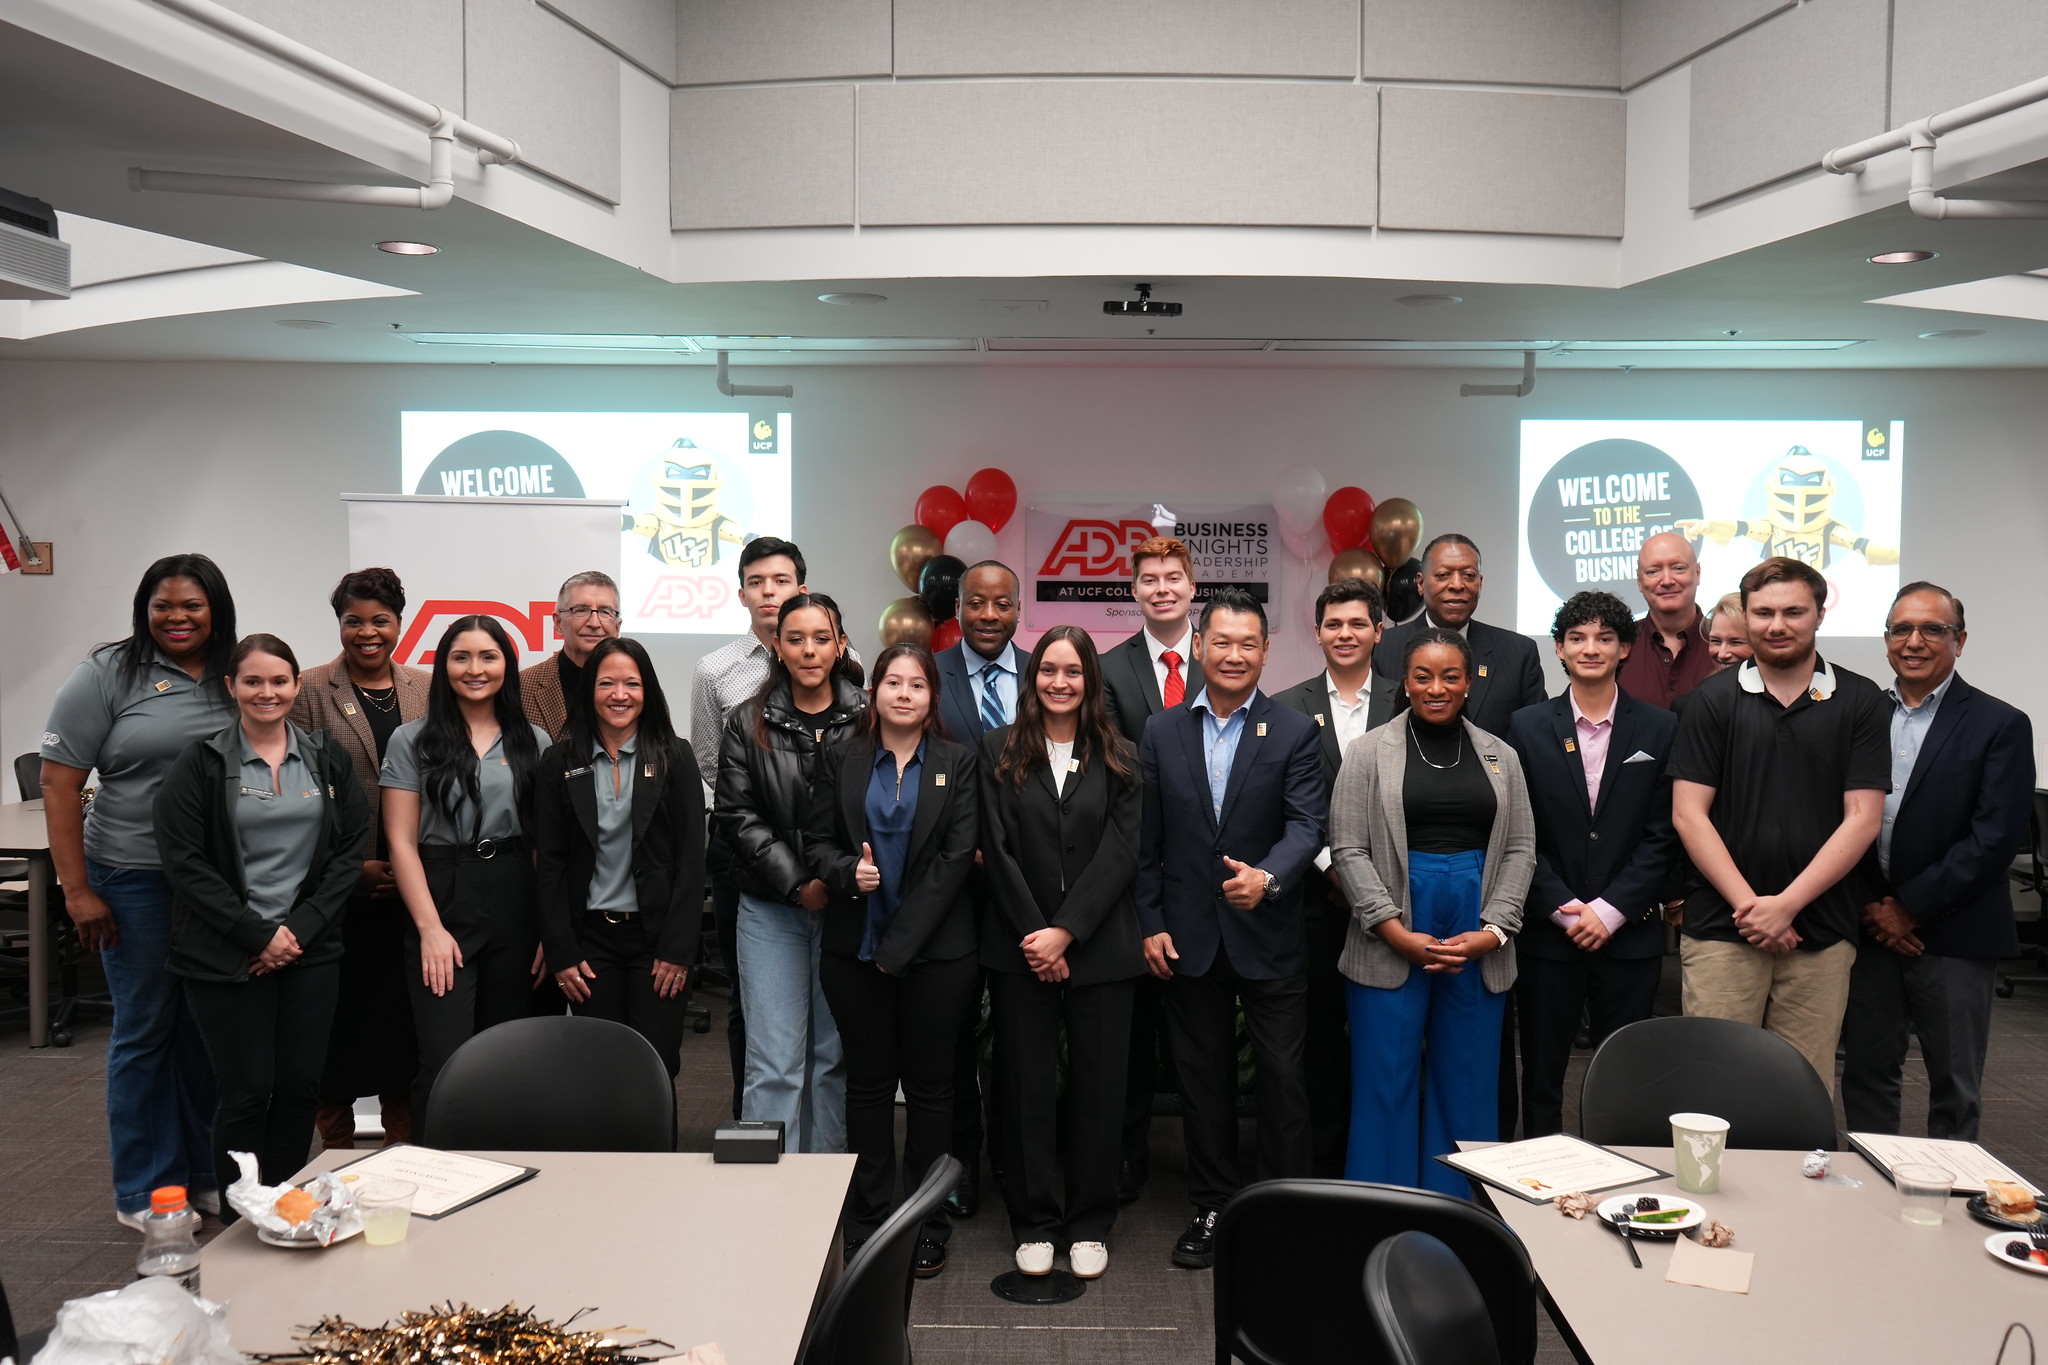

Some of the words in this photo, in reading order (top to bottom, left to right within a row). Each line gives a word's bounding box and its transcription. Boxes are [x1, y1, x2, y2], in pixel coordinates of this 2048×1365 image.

[753, 441, 773, 450] UCF
[1866, 448, 1885, 457] UCF
[440, 464, 555, 497] WELCOME
[1558, 471, 1671, 507] WELCOME
[1593, 507, 1612, 526] TO
[1613, 505, 1642, 524] THE
[1174, 522, 1269, 537] BUSINESS
[1181, 539, 1269, 555] NIGHTS
[1565, 526, 1645, 556] COLLEGE
[661, 531, 709, 568] UCF
[1192, 556, 1269, 568] ADERSHIP
[1201, 569, 1269, 579] ADEMY
[636, 575, 730, 619] ADP
[1059, 587, 1074, 596] AT
[1077, 587, 1102, 596] UCF
[1105, 607, 1142, 618] Sponso
